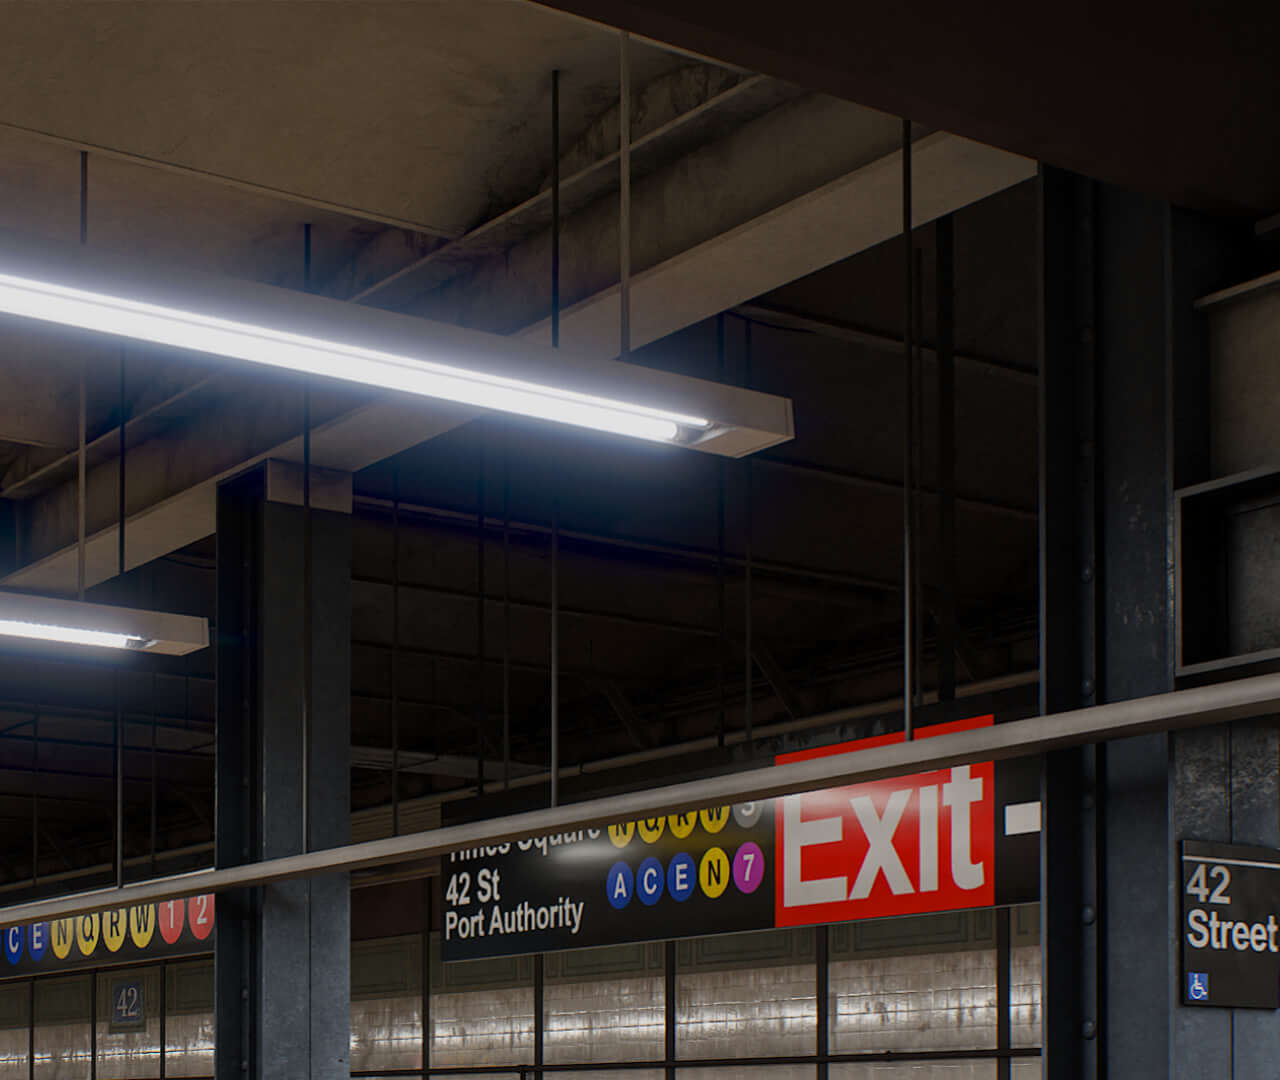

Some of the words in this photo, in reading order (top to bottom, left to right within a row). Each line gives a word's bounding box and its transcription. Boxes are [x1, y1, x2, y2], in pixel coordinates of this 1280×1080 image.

[783, 765, 986, 909] Exit
[445, 871, 471, 906] 42
[477, 867, 501, 902] St
[1185, 863, 1231, 904] 42
[445, 909, 486, 941] Port
[488, 896, 585, 937] Authority
[1187, 908, 1279, 953] Street
[116, 986, 139, 1018] 42
